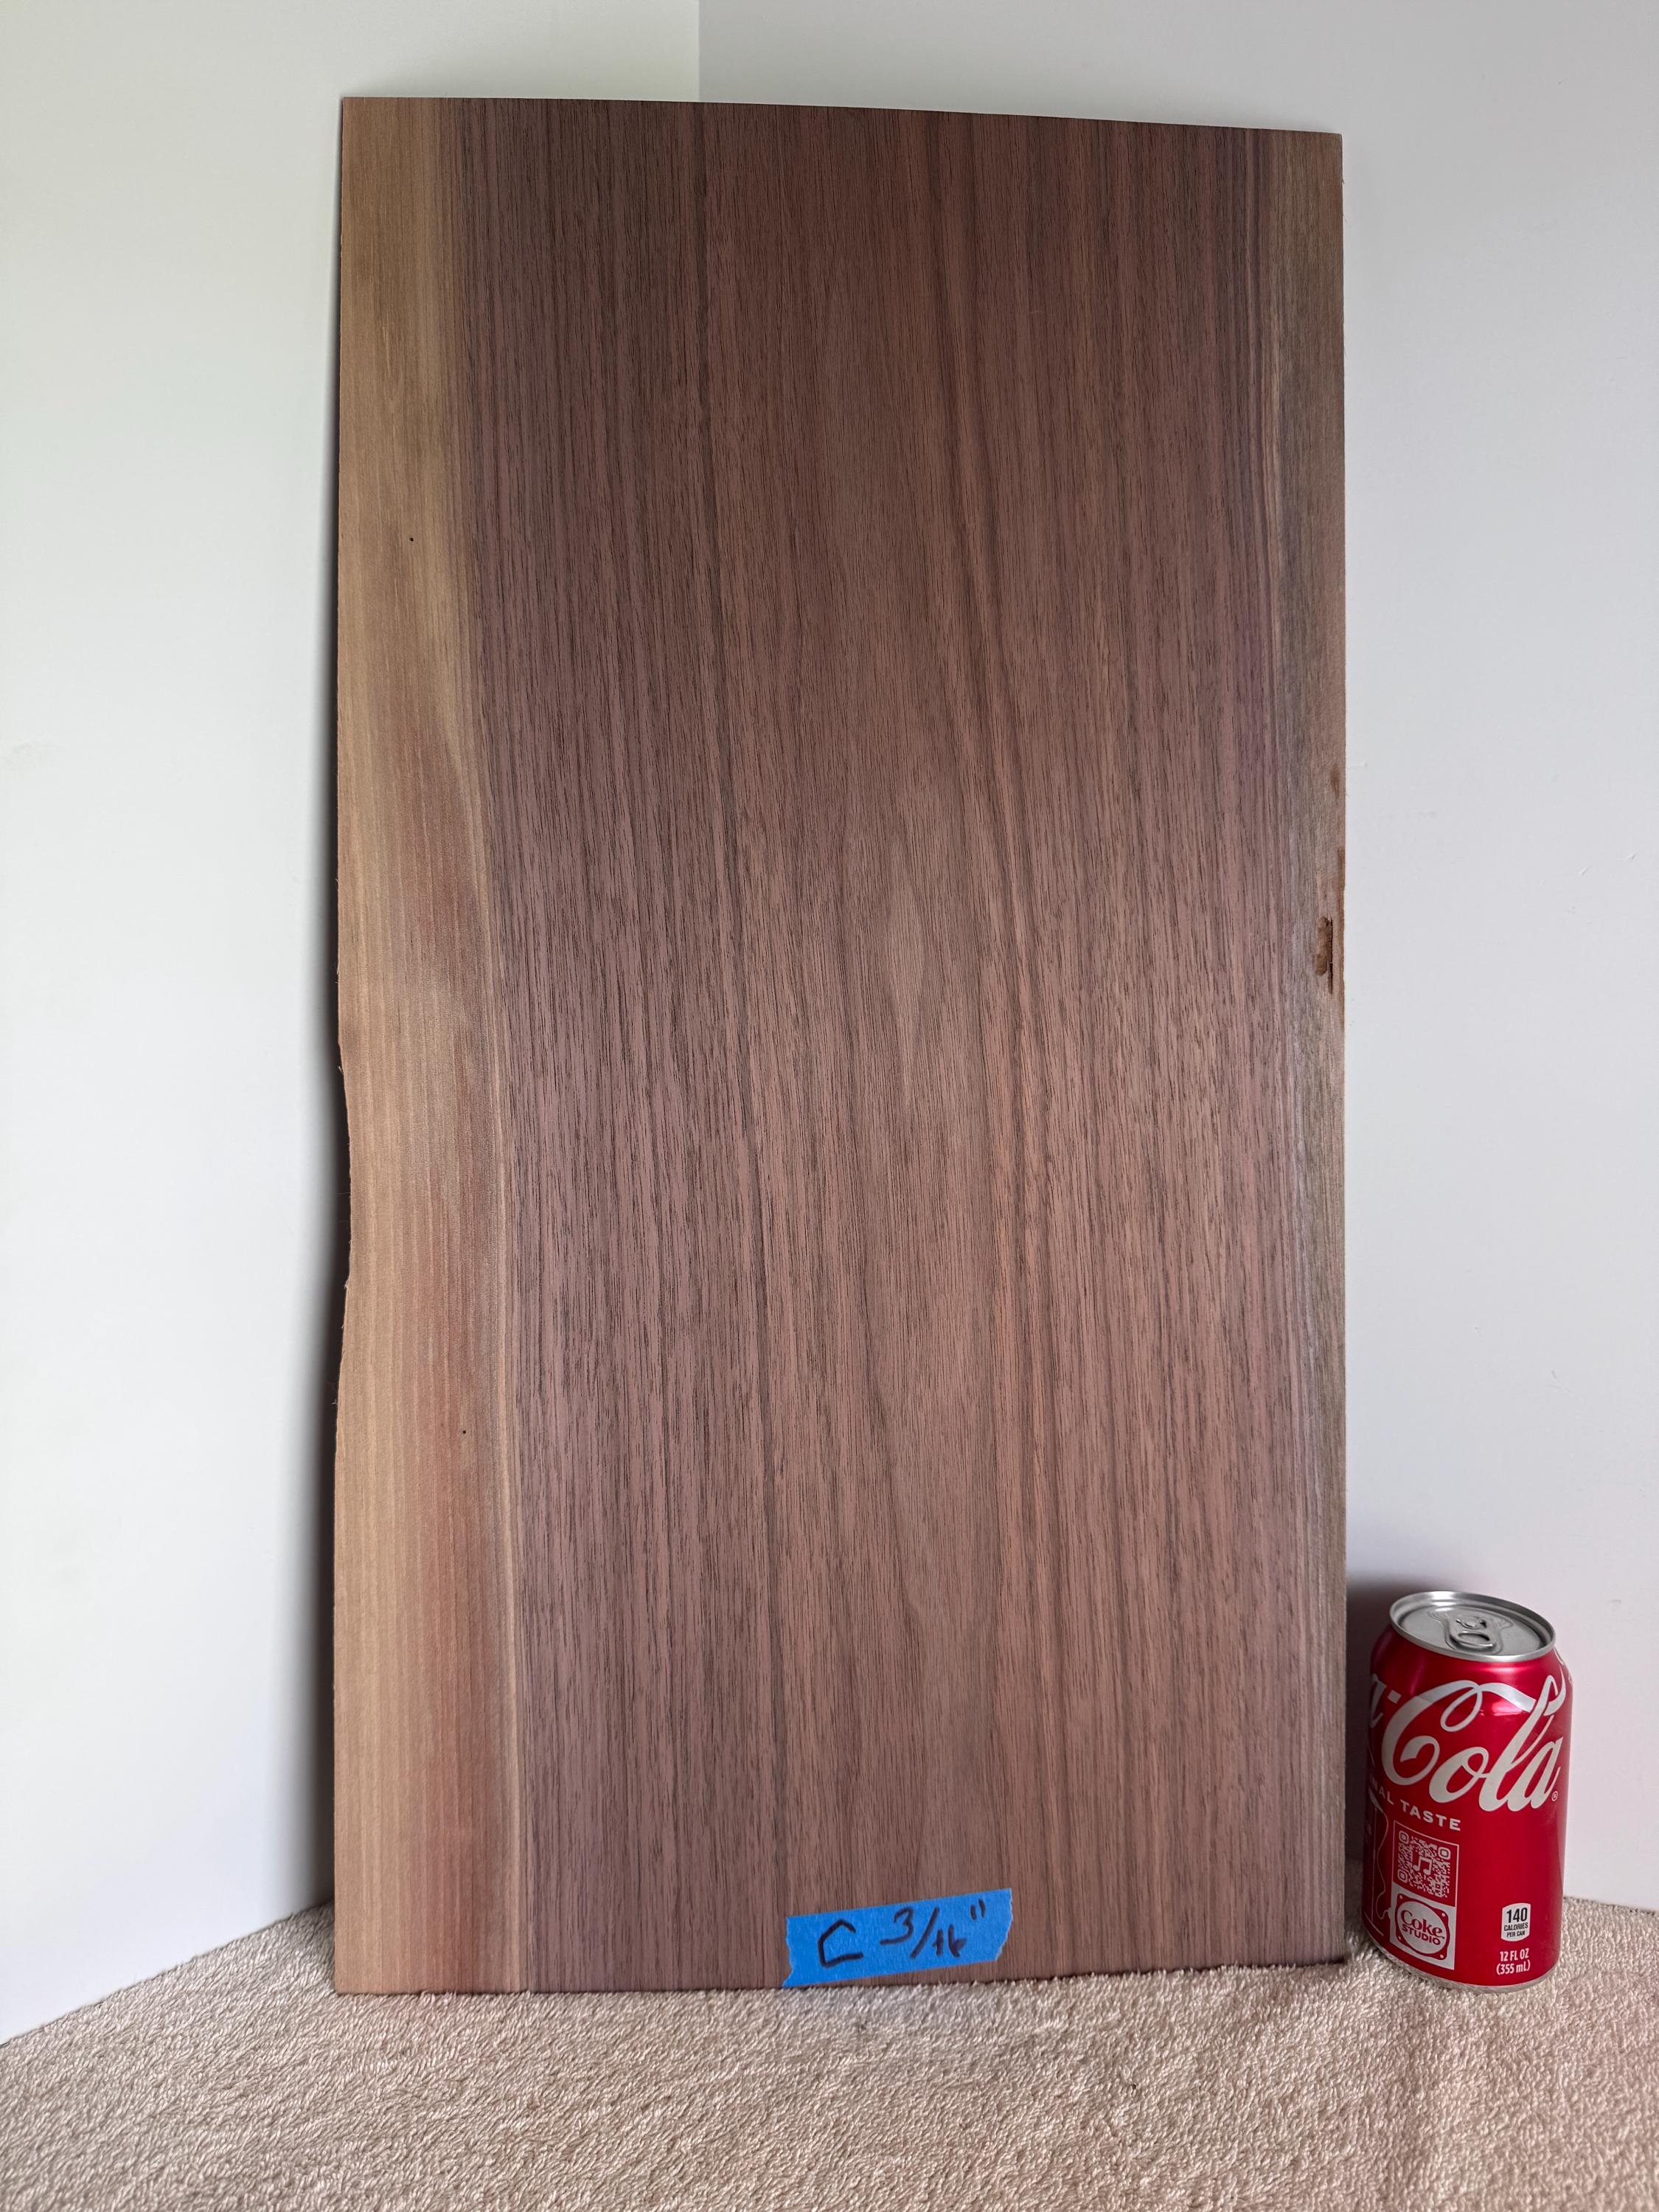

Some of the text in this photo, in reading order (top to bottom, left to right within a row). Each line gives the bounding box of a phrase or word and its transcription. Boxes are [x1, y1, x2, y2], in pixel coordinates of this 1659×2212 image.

[1400, 1799, 1461, 1832] TASTE
[1401, 1910, 1445, 1940] Coke
[1506, 1907, 1528, 1924] 140
[1402, 1924, 1441, 1946] STUDIO
[1503, 1922, 1528, 1932] CALORIES
[817, 1919, 864, 1968] C
[1499, 1948, 1529, 1962] 12 FL OZ
[1496, 1959, 1531, 1975] (355 mL)
